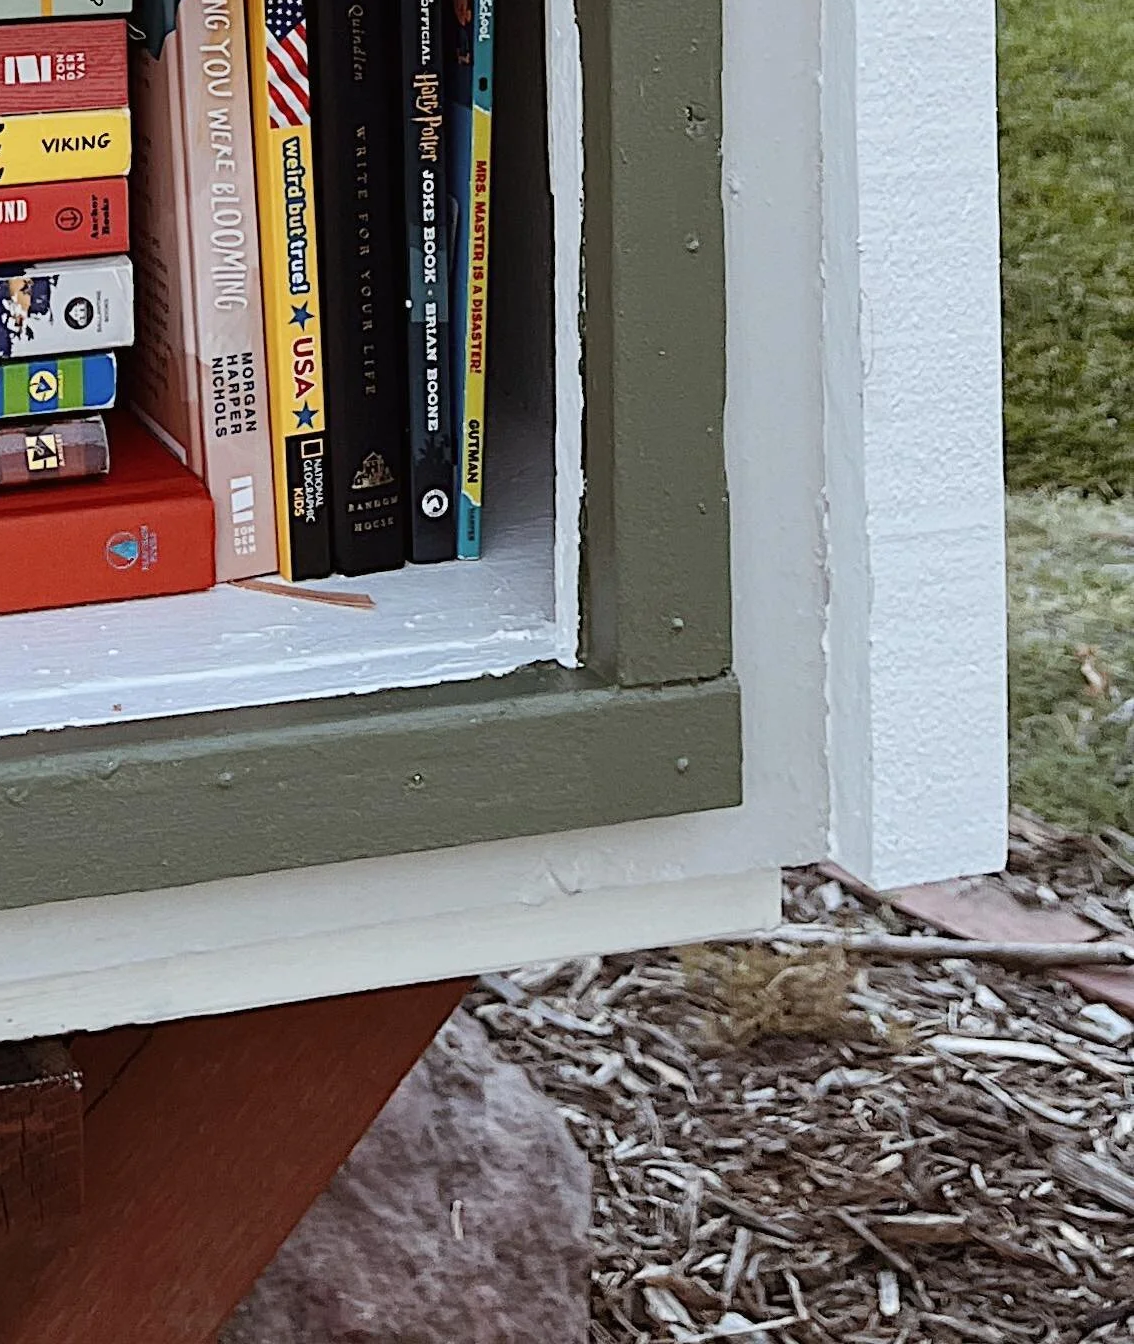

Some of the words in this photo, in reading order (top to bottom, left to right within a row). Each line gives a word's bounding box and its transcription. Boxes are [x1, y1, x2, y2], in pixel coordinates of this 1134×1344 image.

[55, 54, 65, 80] ZON
[67, 53, 75, 80] DER
[76, 52, 85, 79] VAN
[199, 37, 234, 98] YOU
[348, 4, 366, 81] Quindlen
[413, 72, 438, 115] Harry
[42, 132, 111, 153] VIKING
[206, 107, 236, 174] WERE
[354, 126, 368, 199] WRITE
[409, 115, 443, 162] Potter
[281, 138, 304, 199] weird
[421, 169, 435, 221] JOKE
[90, 194, 99, 240] Anchor
[102, 197, 110, 237] Books
[286, 202, 305, 236] but
[357, 214, 369, 255] FOR
[204, 181, 250, 311] BLOOMING
[288, 239, 308, 292] true!
[423, 226, 435, 283] BOOK
[359, 270, 372, 330] YOUR
[424, 303, 437, 361] BRIAN
[225, 354, 243, 434] HARPER
[240, 352, 257, 432] MORGAN
[290, 337, 317, 398] USA
[363, 345, 376, 396] LIFE
[210, 357, 228, 438] NICHOLS
[425, 368, 438, 431] BOONE
[466, 419, 481, 483] GUTMAN
[292, 487, 304, 517] KIDS
[301, 459, 317, 523] GEOGRAPHIC
[311, 458, 324, 507] NATIONAL
[347, 495, 398, 512] RANDOM
[353, 517, 394, 531] HOUSE
